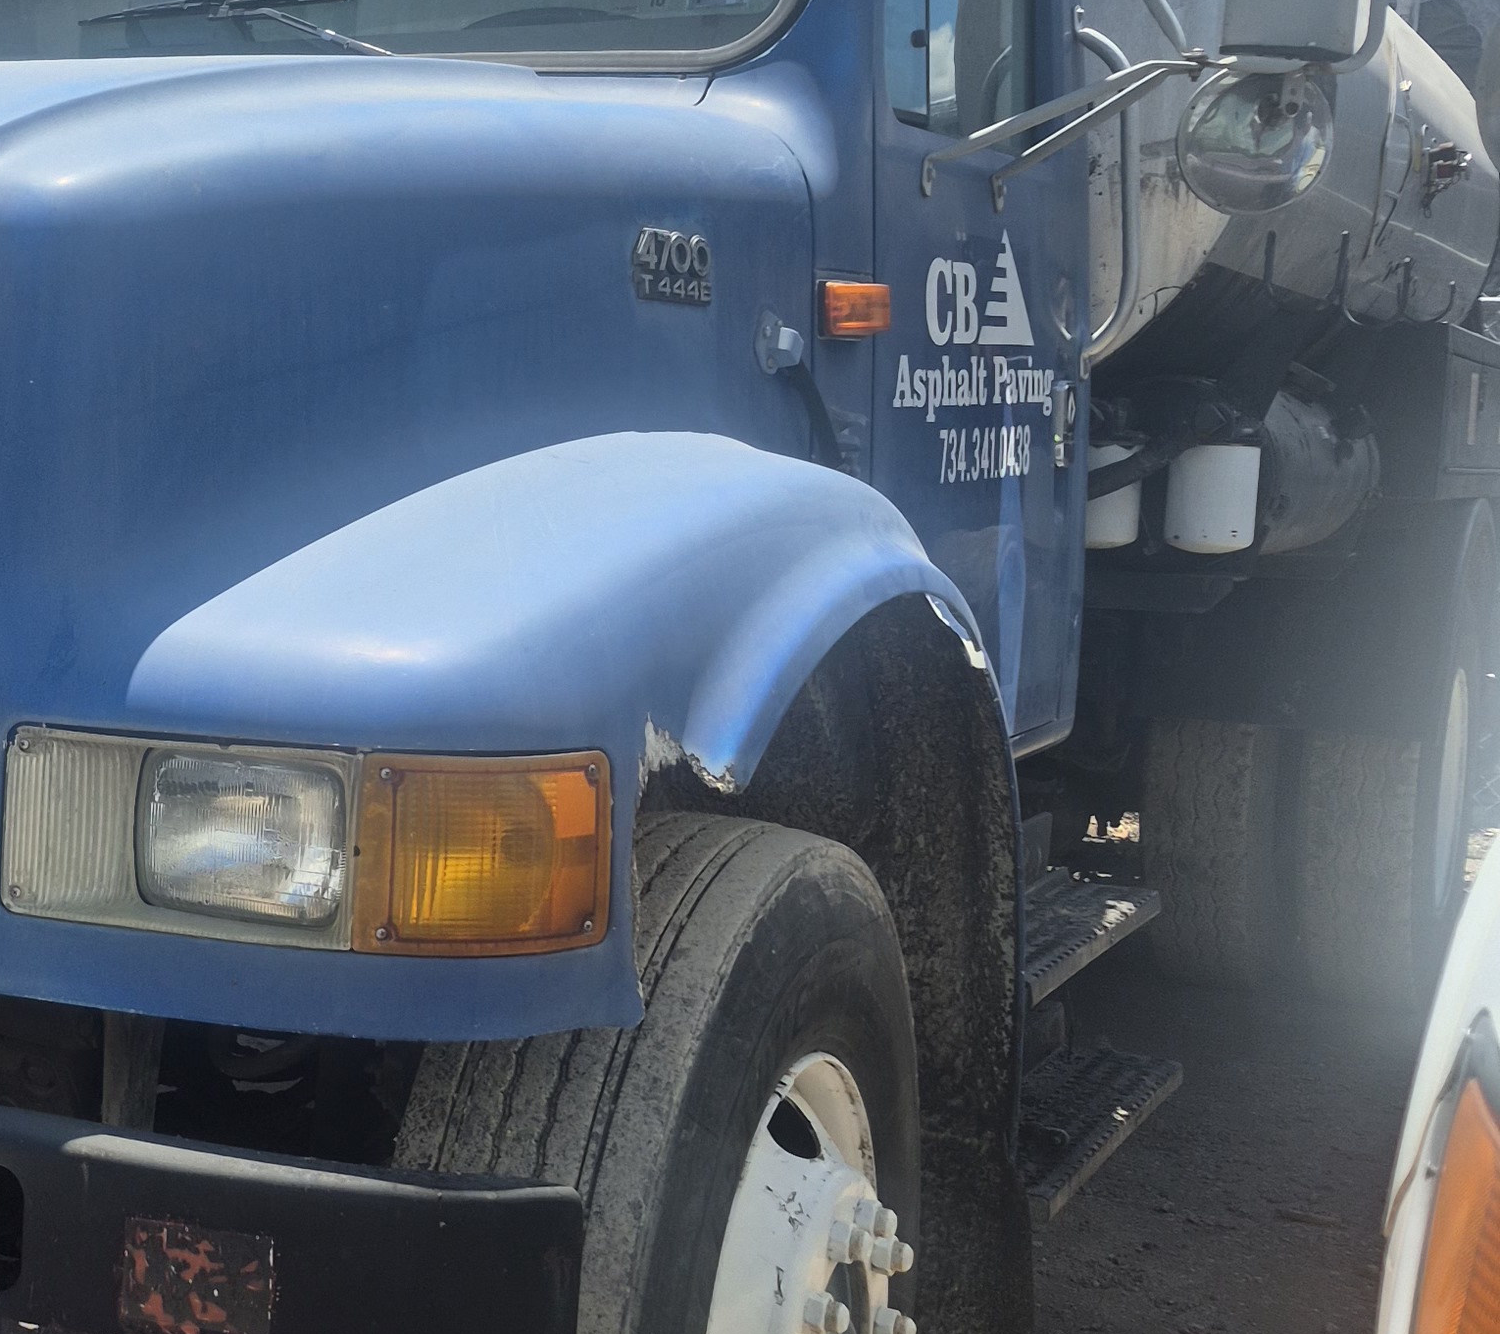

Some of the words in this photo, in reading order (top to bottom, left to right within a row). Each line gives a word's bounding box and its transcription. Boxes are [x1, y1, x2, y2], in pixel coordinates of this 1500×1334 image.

[636, 227, 712, 277] 4700
[892, 354, 988, 423] Asphalt
[992, 355, 1055, 417] Paving
[939, 424, 1032, 484] 734.341.0438
